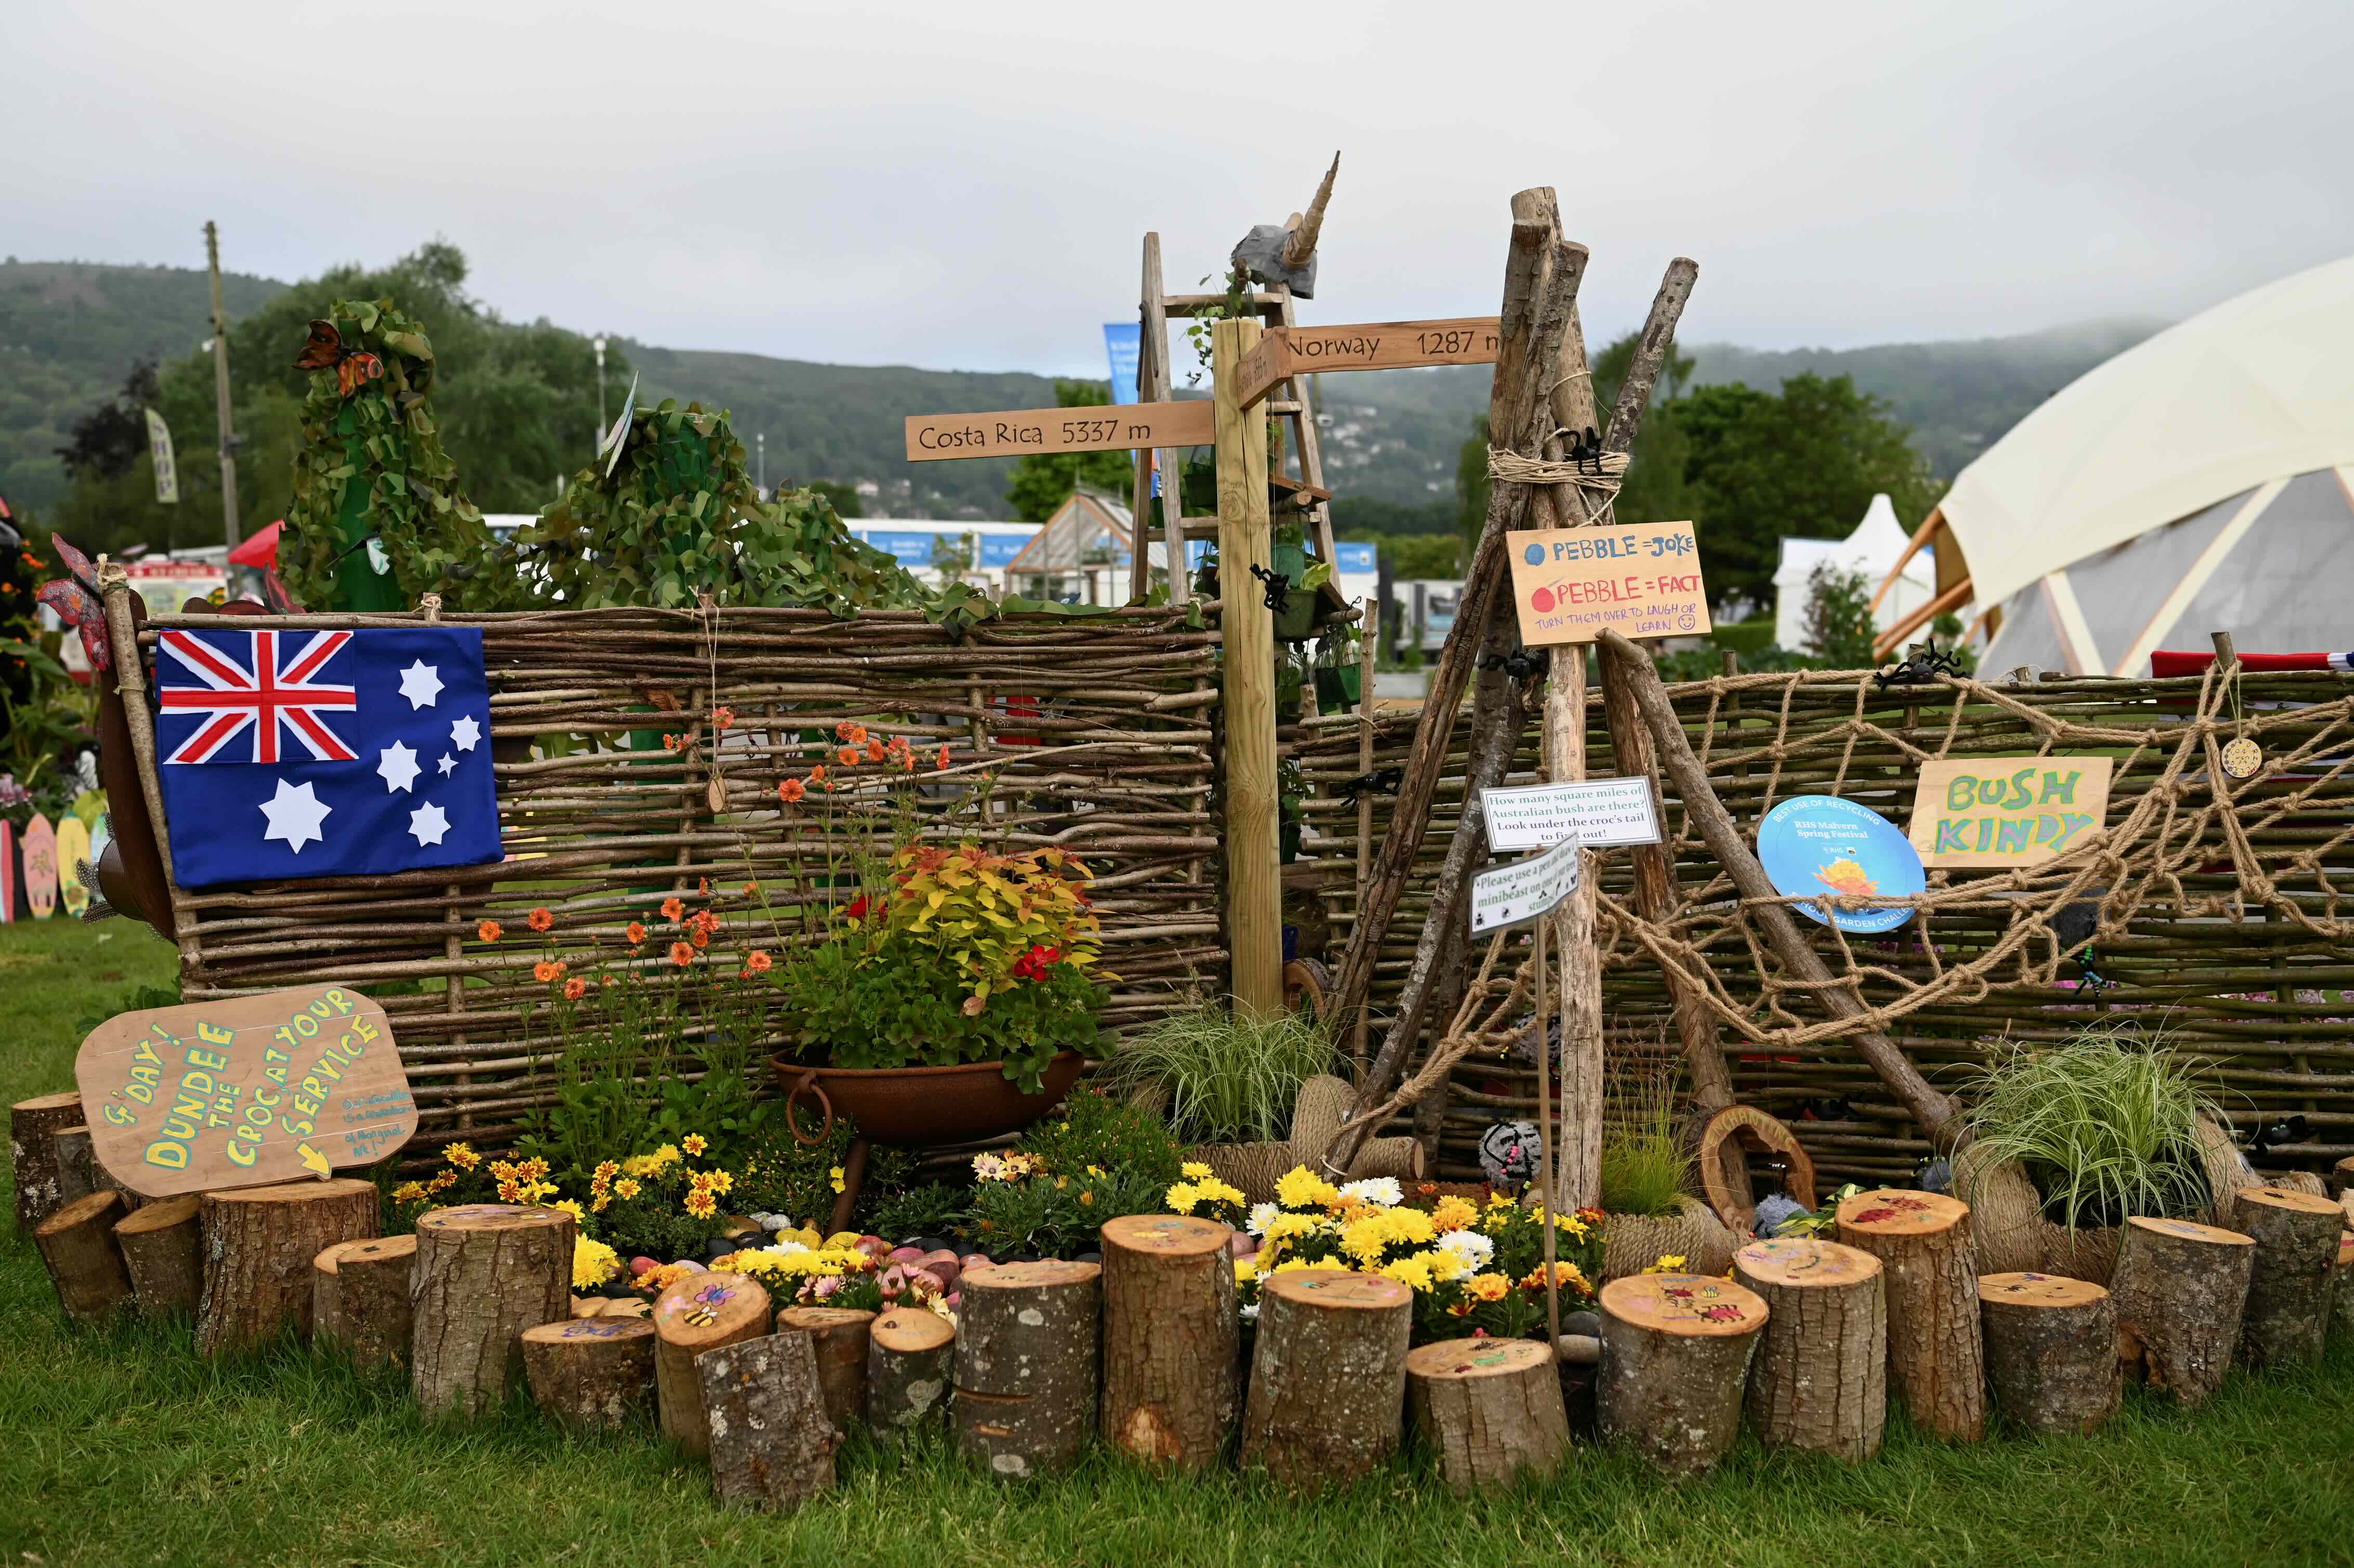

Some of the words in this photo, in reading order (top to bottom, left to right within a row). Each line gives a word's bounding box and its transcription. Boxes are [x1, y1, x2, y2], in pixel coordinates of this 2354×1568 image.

[1289, 336, 1381, 361] Norway
[1417, 330, 1475, 355] 1287
[919, 426, 986, 449] Costa
[996, 423, 1043, 445] Rica
[1063, 420, 1119, 444] 5337
[1128, 424, 1151, 440] m
[1553, 535, 1638, 561] PEBBLE
[1557, 577, 1643, 604] PEBBLE
[1657, 575, 1702, 594] FACT
[1536, 618, 1564, 630] TURN
[1567, 611, 1601, 624] THEM
[1604, 609, 1629, 621] OVER
[1629, 607, 1643, 618] TO
[1647, 603, 1678, 616] LAUGH
[1681, 603, 1696, 613] OR
[1636, 619, 1672, 633] LEARN
[1489, 796, 1516, 806] How
[1519, 795, 1551, 805] many
[1554, 792, 1593, 802] square
[1597, 788, 1628, 798] miles
[1631, 786, 1643, 795] of
[1947, 767, 2082, 812] BUSH
[1492, 808, 1552, 819] Australian
[1557, 804, 1585, 815] bush
[1587, 804, 1606, 812] are
[1609, 800, 1645, 811] there?
[1497, 819, 1527, 831] Look
[1531, 818, 1565, 829] under
[1568, 816, 1588, 827] the
[1625, 813, 1645, 822] tail
[1773, 805, 1792, 823] BEST
[1791, 800, 1809, 810] USE
[1810, 799, 1823, 807] OF
[1826, 800, 1881, 826] RECYCLING
[1556, 831, 1579, 840] fi
[1584, 829, 1607, 839] out!
[1794, 820, 1816, 829] RHS
[1817, 820, 1860, 830] Malvern
[1797, 830, 1830, 840] Spring
[1830, 830, 1868, 839] Festival
[1934, 813, 2096, 856] KINDY
[1482, 874, 1513, 888] Please
[1515, 869, 1531, 880] use
[1478, 885, 1528, 908] minibeast
[1530, 883, 1540, 893] on
[1833, 916, 1876, 927] GARDEN
[1877, 907, 1914, 925] CHALLE
[274, 988, 357, 1047] YOUR
[104, 1023, 183, 1126] G'DAY!
[265, 1044, 292, 1087] AT
[280, 1014, 381, 1139] SERVICE
[144, 1021, 236, 1170] DUNDEE
[207, 1081, 242, 1130] THE
